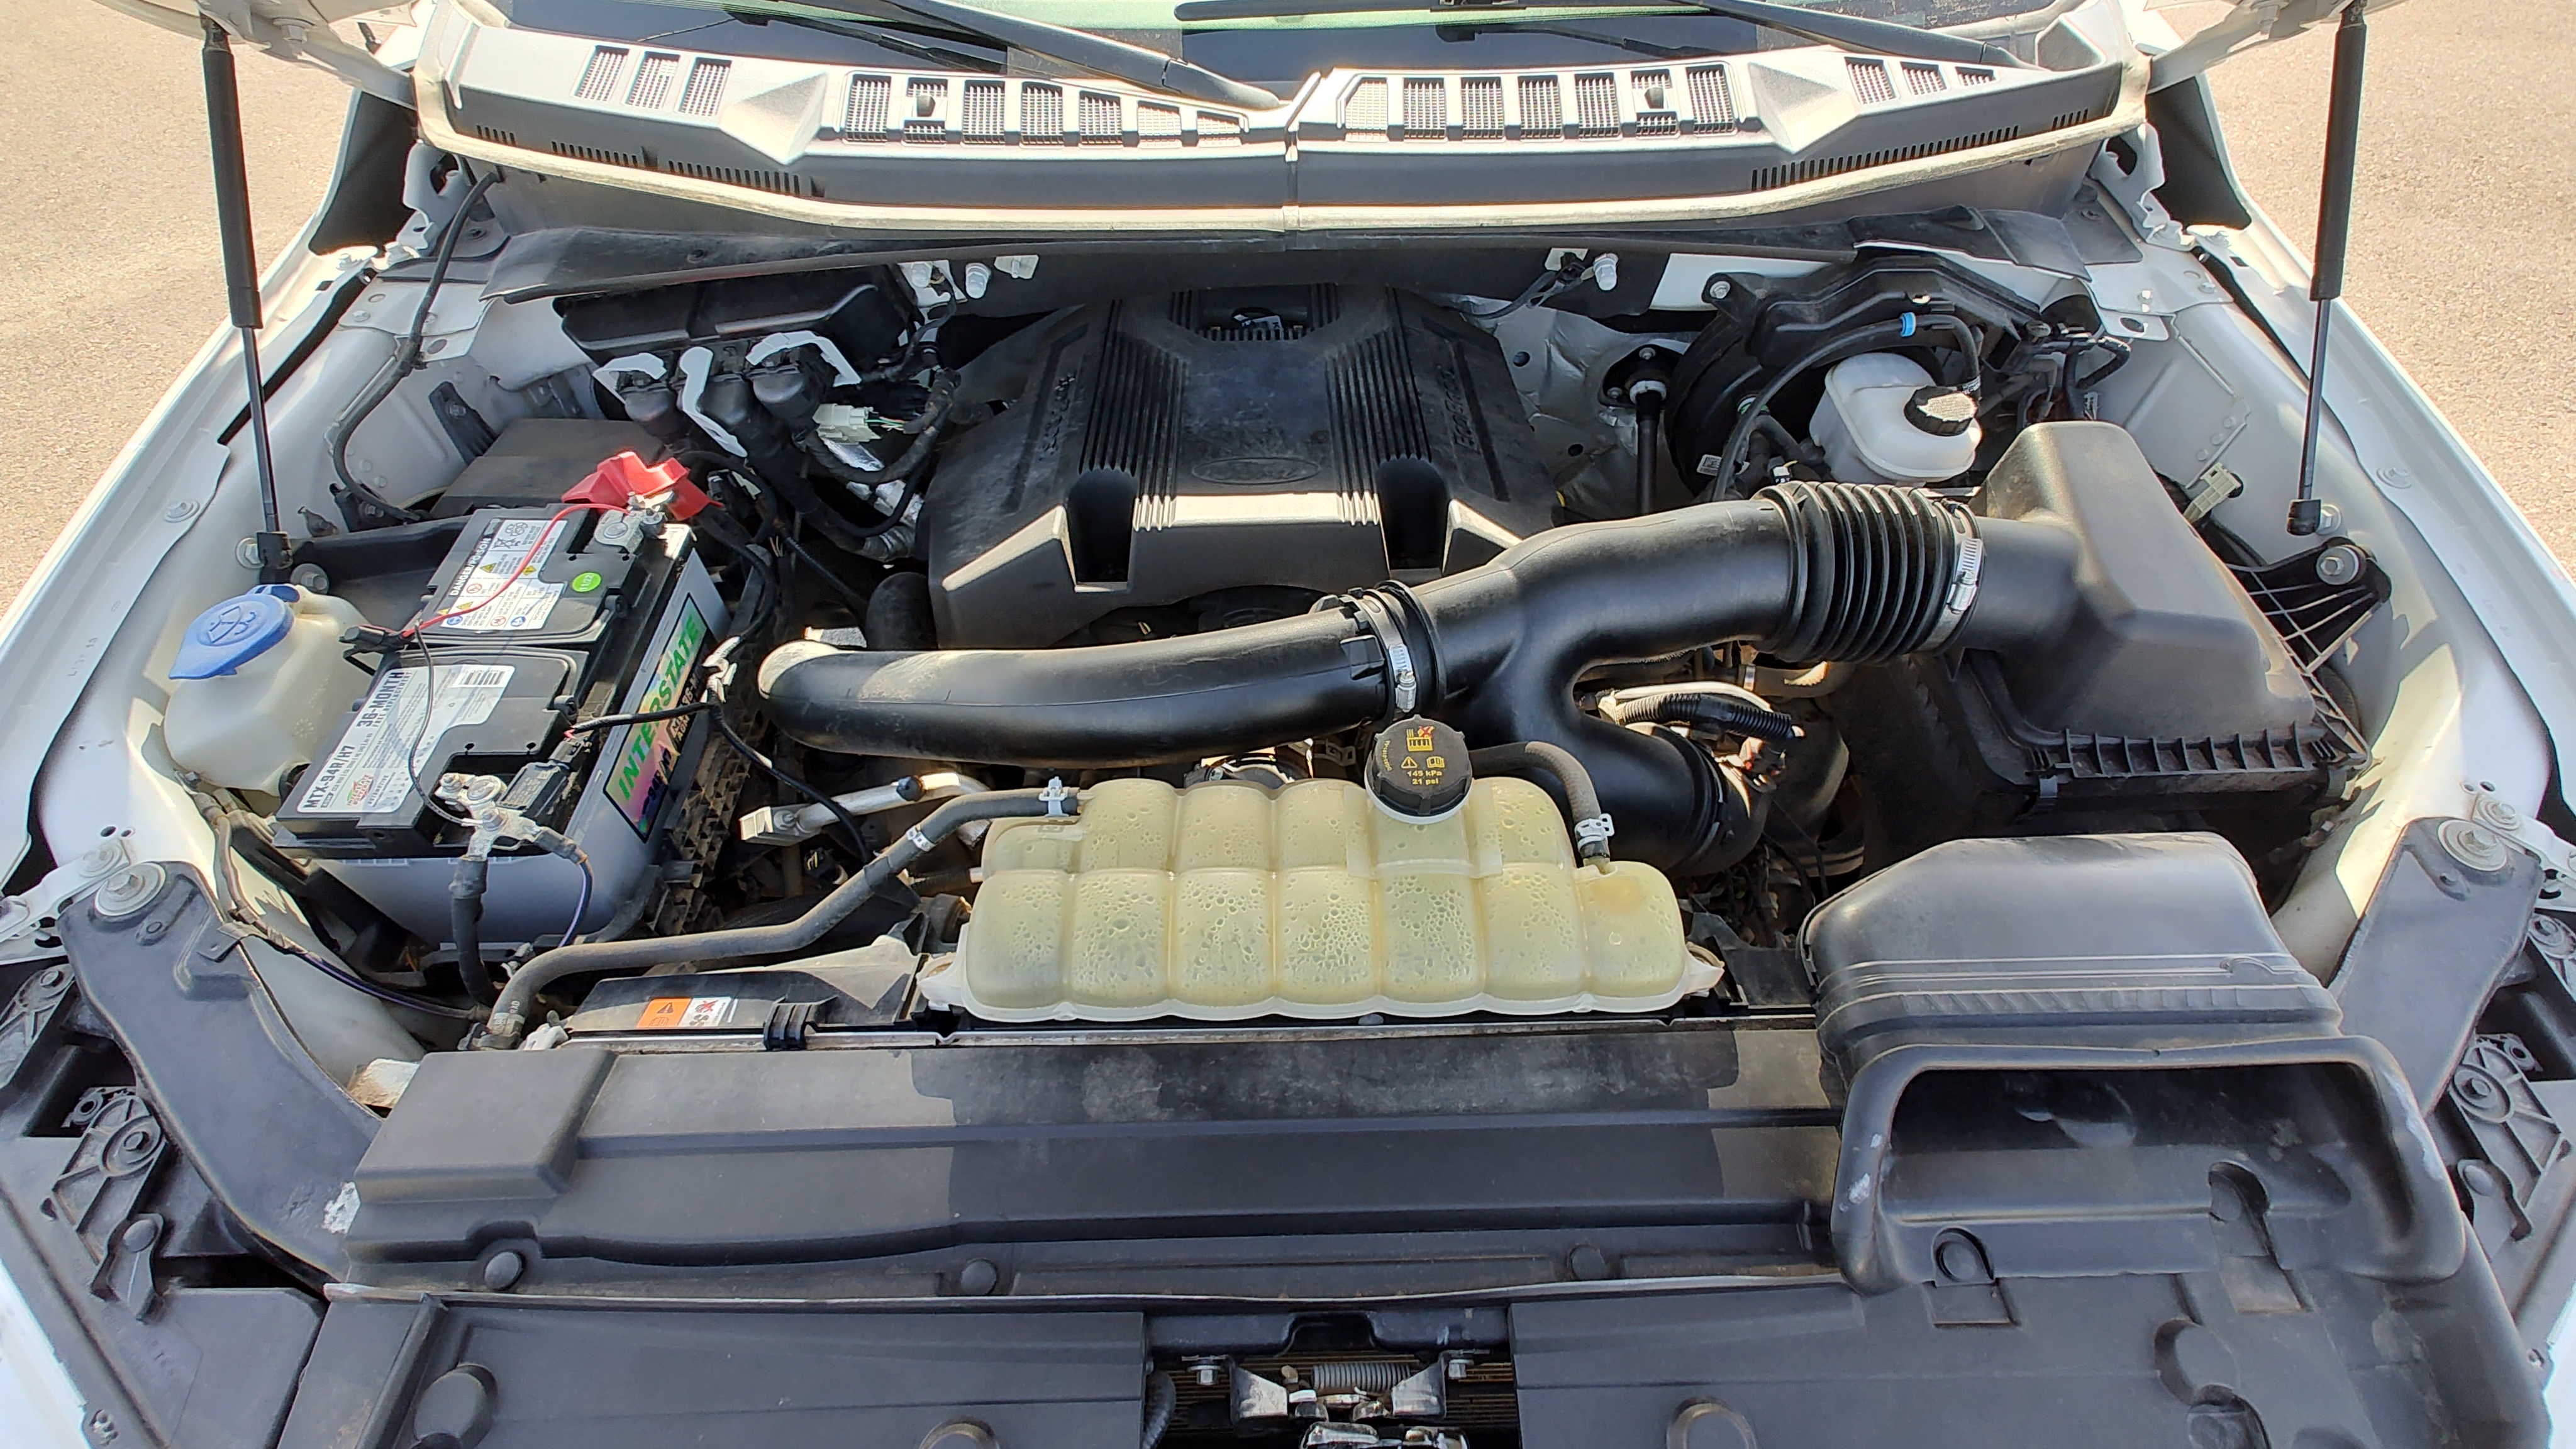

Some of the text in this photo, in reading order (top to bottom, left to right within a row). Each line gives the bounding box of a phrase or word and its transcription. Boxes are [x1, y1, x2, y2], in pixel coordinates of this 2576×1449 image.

[579, 574, 594, 591] 11/22
[356, 672, 404, 727] 36-MONTH
[619, 614, 698, 799] INTERSTATE
[303, 745, 355, 808] MTX-94R/H7
